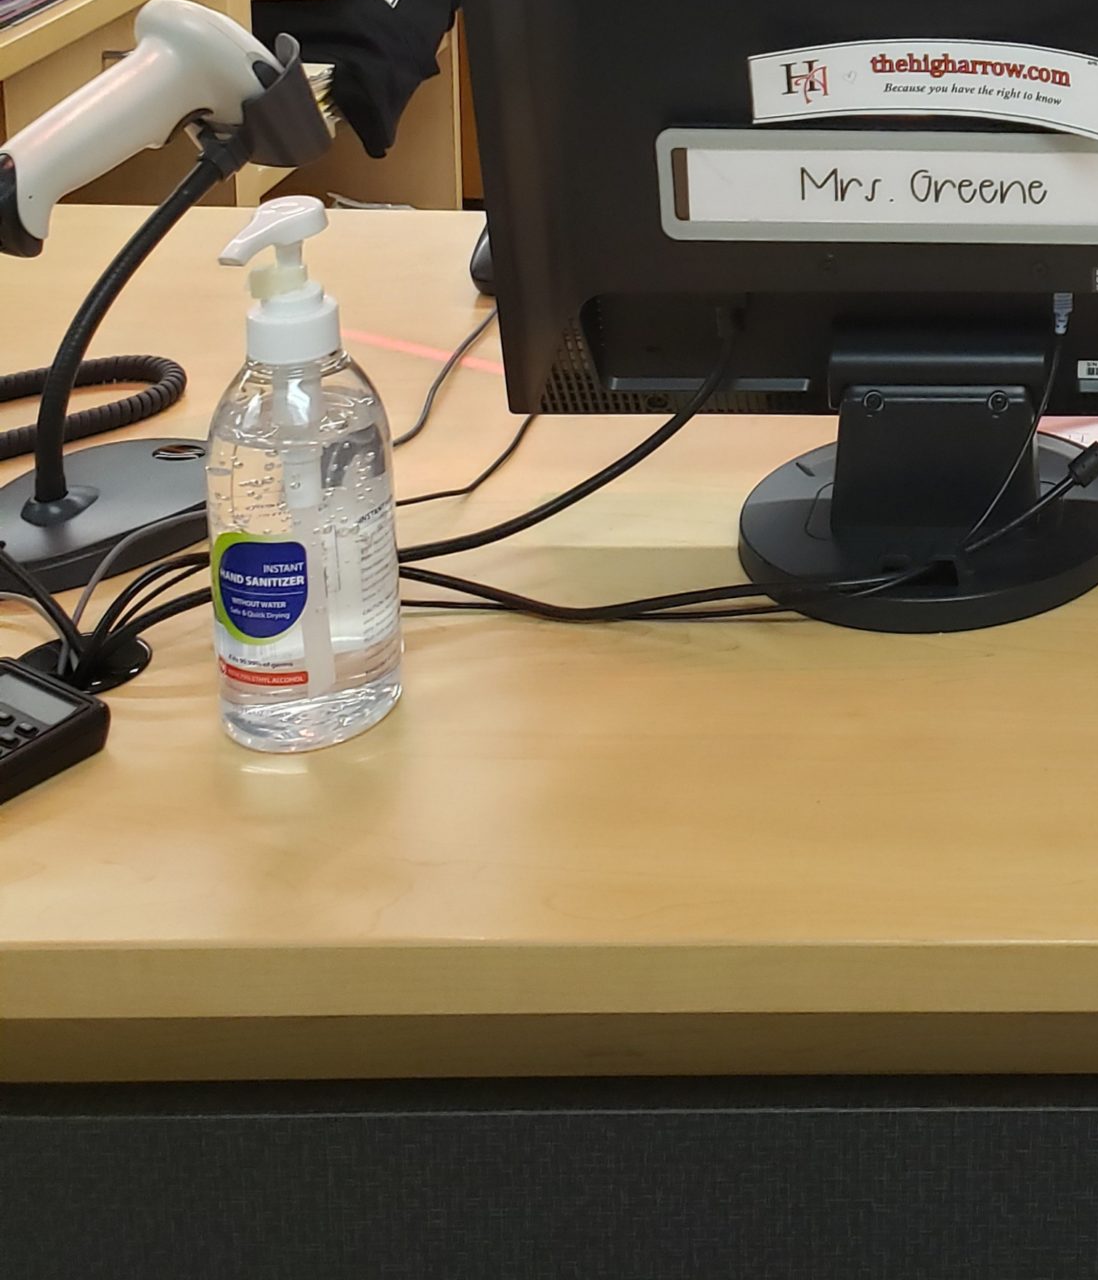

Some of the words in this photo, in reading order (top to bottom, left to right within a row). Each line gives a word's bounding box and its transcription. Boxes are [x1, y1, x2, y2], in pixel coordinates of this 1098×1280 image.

[870, 53, 1071, 87] thehigharrow.com
[883, 82, 926, 93] Because
[928, 85, 948, 95] you
[951, 83, 976, 94] have
[978, 84, 994, 96] the
[996, 87, 1021, 100] right
[1023, 90, 1033, 100] to
[1035, 91, 1063, 106] know
[799, 166, 895, 204] Mrs.
[910, 168, 1049, 206] Greene
[263, 561, 305, 573] INSTANT
[220, 569, 244, 586] HAND
[245, 575, 305, 587] SANITIZER
[231, 597, 260, 608] WITHOUT
[260, 600, 287, 608] WATER
[247, 610, 266, 619] Quick
[266, 611, 290, 620] Drying
